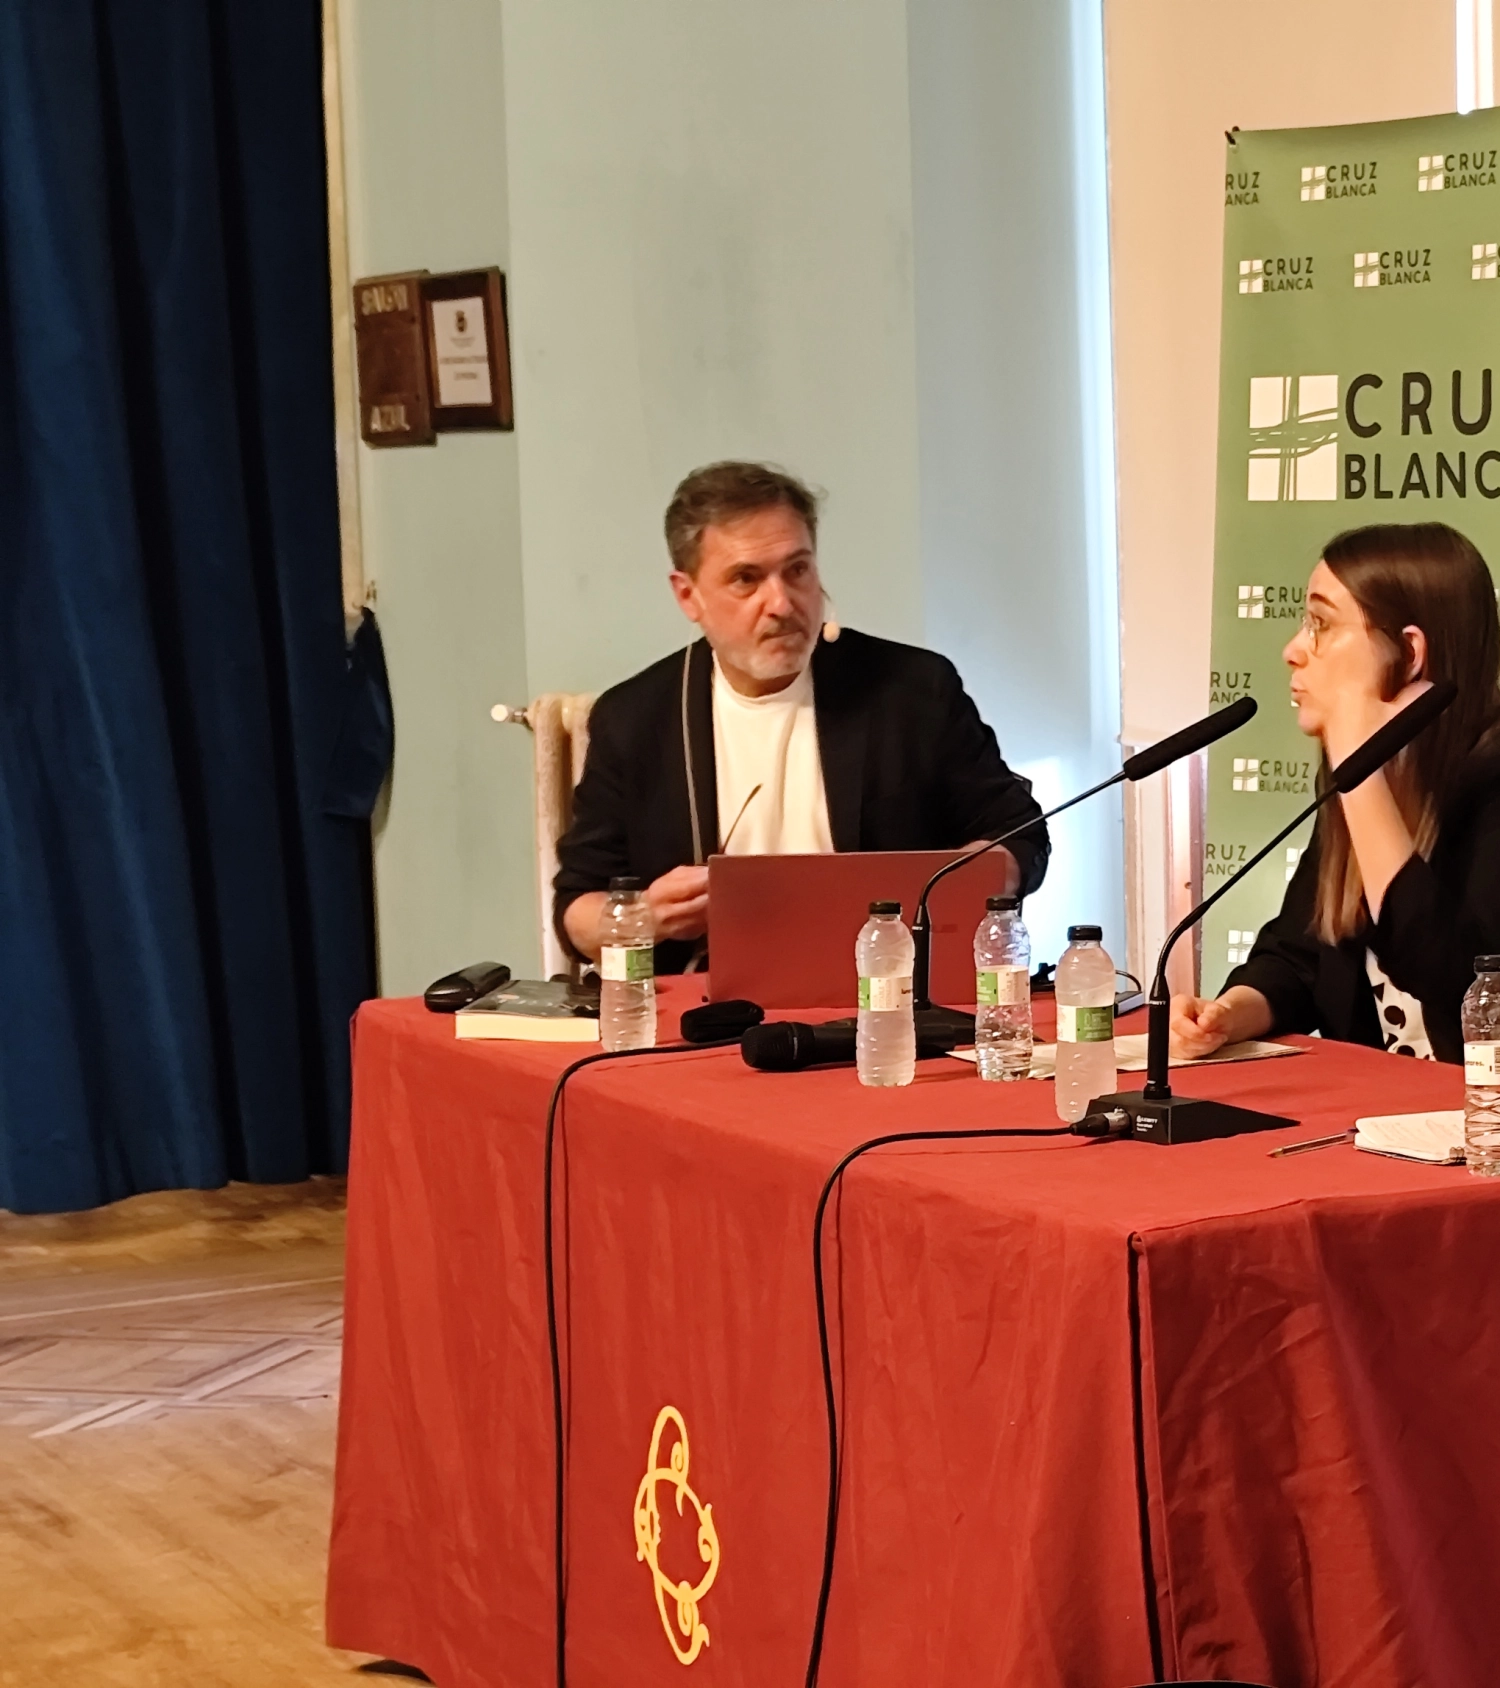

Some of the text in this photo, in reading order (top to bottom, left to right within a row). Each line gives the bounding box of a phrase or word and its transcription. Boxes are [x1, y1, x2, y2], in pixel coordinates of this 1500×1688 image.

[1444, 150, 1498, 173] CRUZ
[1225, 171, 1260, 191] RUZ
[1325, 162, 1378, 183] CRUZ
[1444, 172, 1497, 190] BLANCA
[1325, 183, 1377, 200] BLANCA
[1263, 256, 1314, 276] CRUZ
[1379, 248, 1432, 269] CRUZ
[1262, 277, 1314, 293] BLANCA
[1379, 270, 1431, 287] BLANCA
[1264, 586, 1308, 603] CRU
[1210, 671, 1252, 689] RUZ
[1210, 691, 1250, 704] ANC
[1260, 760, 1310, 779] CRUZ
[1259, 780, 1309, 794] BLANCA
[1205, 843, 1247, 862] RUZ
